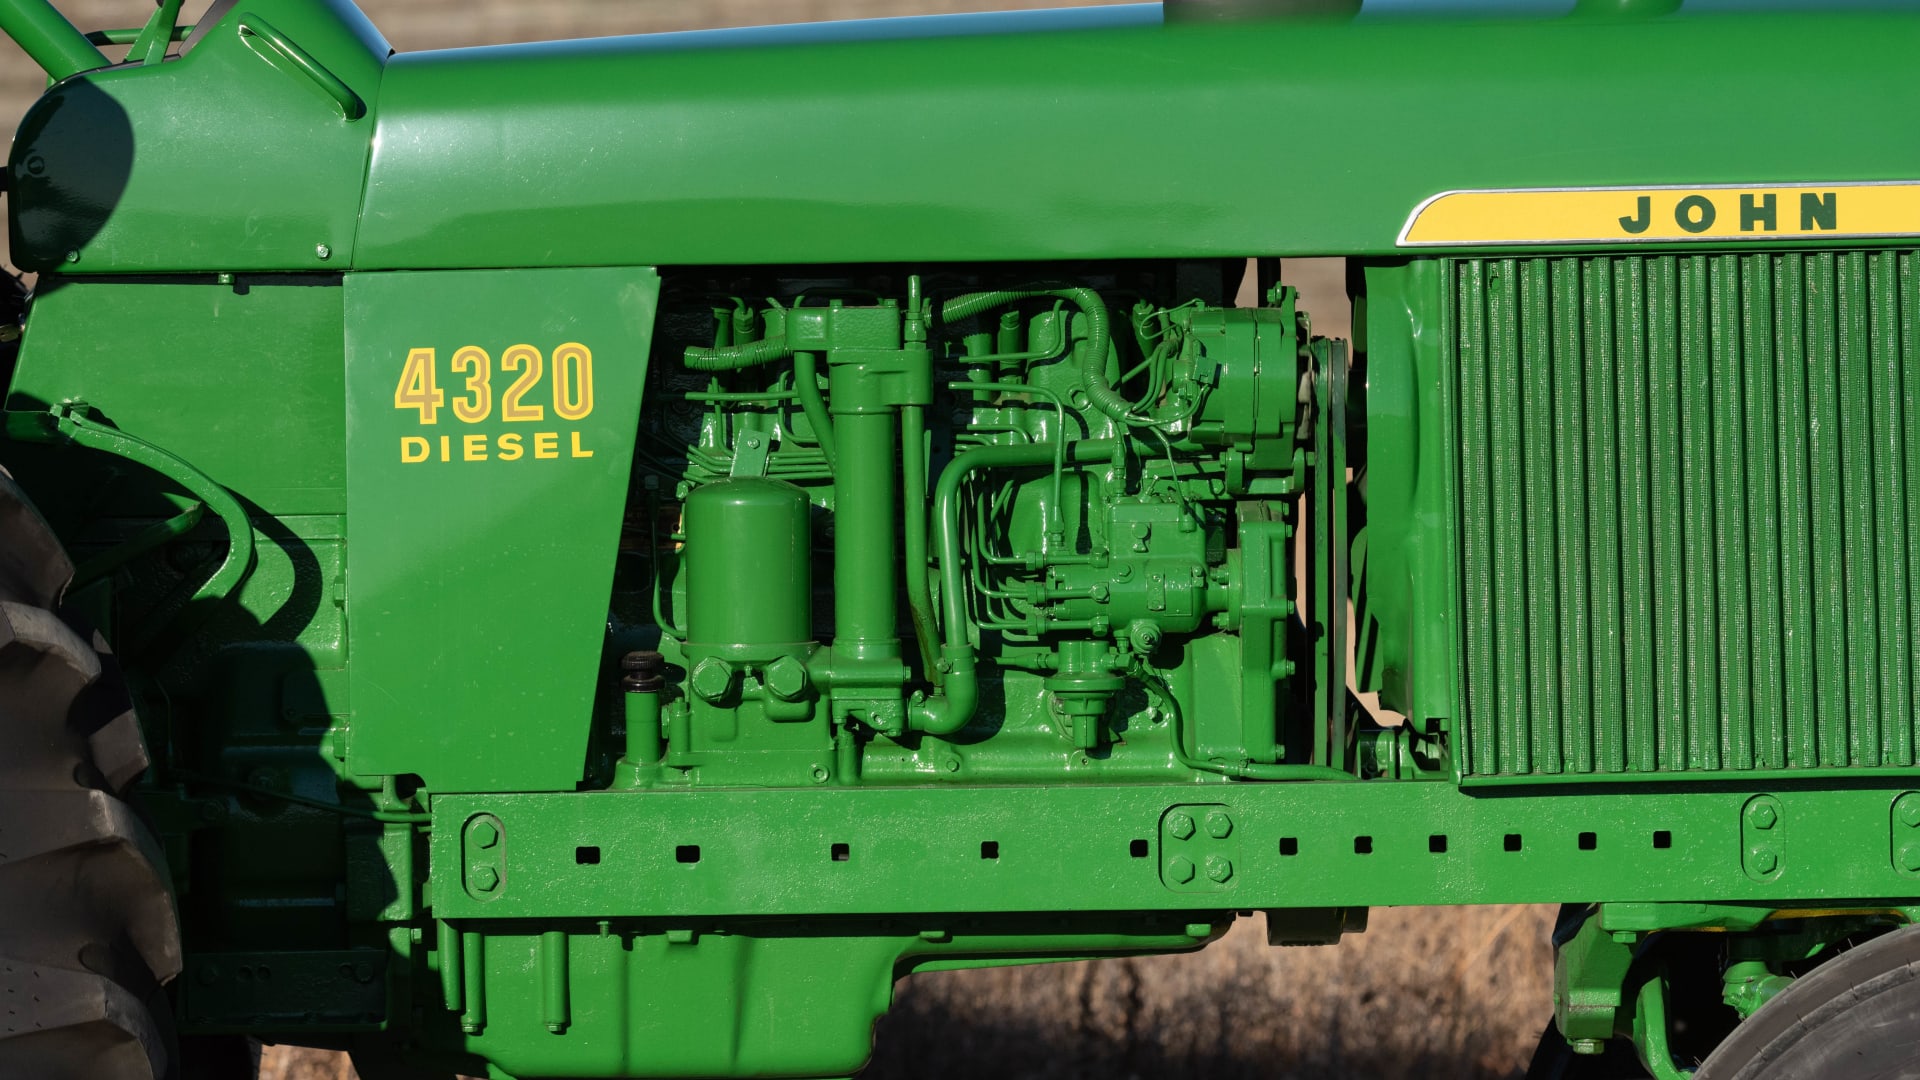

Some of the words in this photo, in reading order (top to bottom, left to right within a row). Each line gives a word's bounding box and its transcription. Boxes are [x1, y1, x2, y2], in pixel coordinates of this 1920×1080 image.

[1618, 192, 1837, 234] JOHN
[394, 342, 594, 425] 4320
[401, 431, 594, 464] DIESEL
